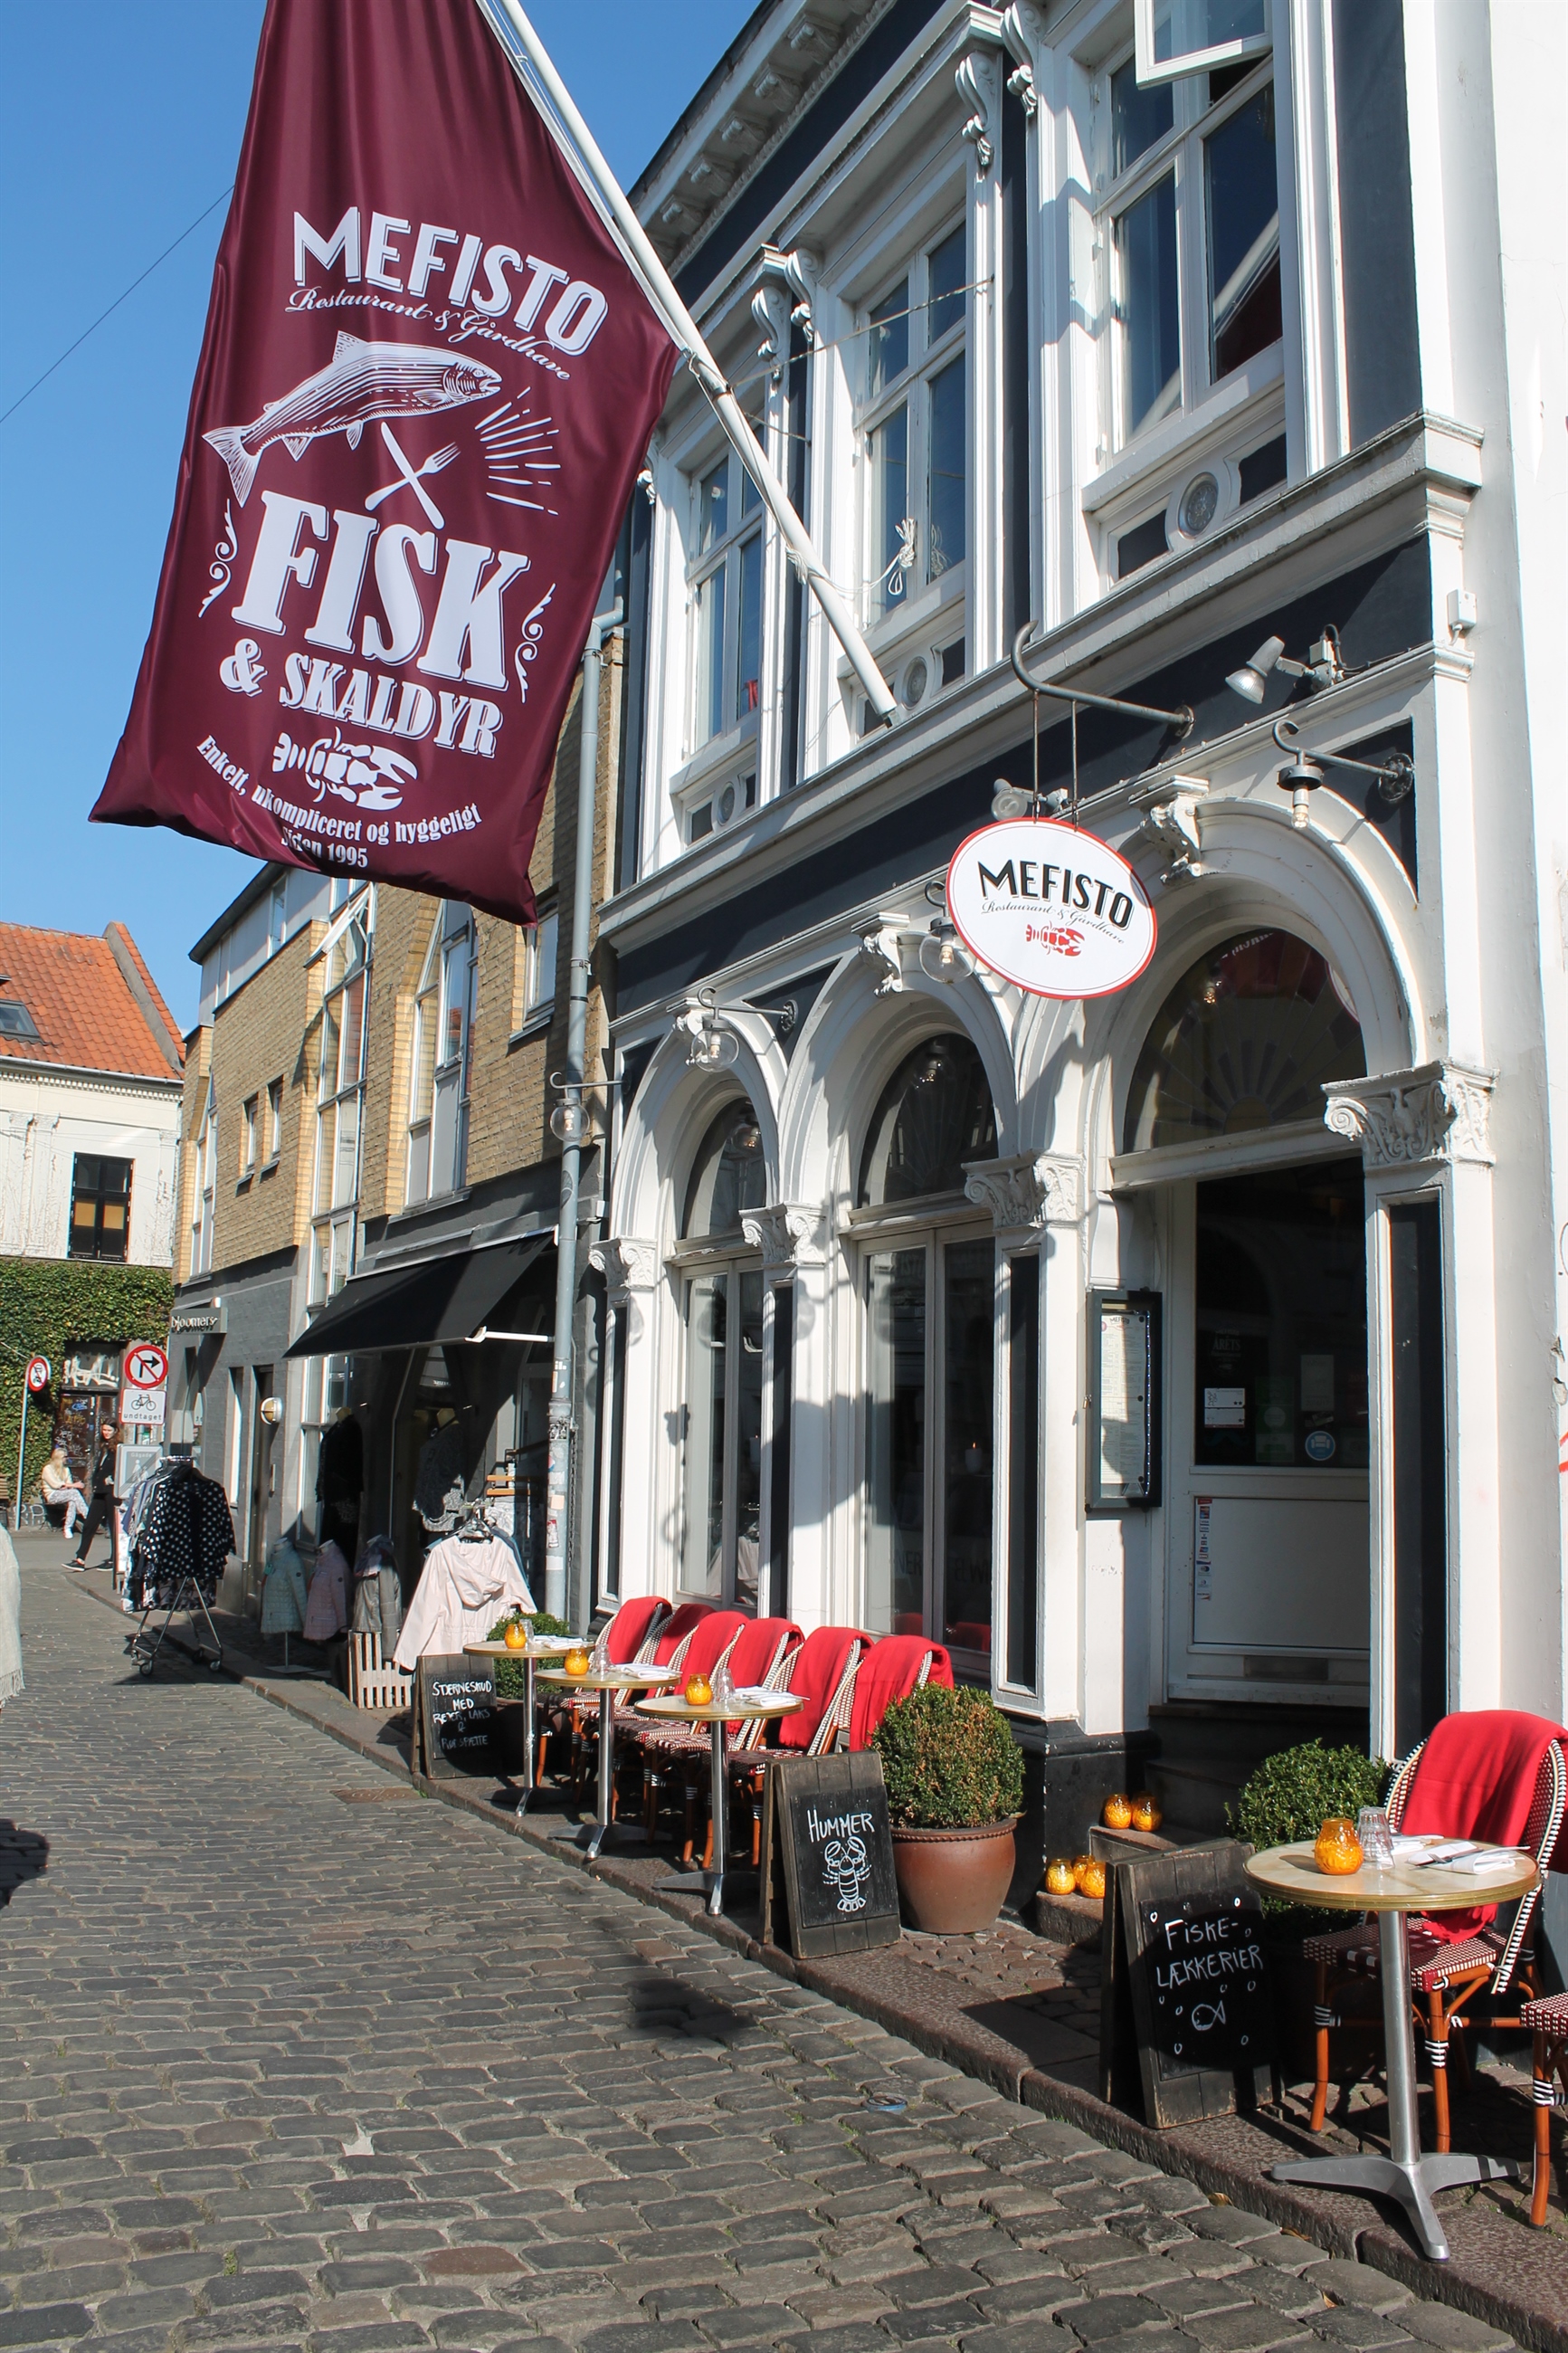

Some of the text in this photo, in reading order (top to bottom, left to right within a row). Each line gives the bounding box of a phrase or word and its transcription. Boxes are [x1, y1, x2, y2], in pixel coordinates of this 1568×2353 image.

[294, 206, 609, 356] MEFISTO
[285, 287, 571, 380] Restaurant & Gårdhave
[231, 491, 531, 691] FISK
[220, 638, 503, 758] & SKALDYR
[196, 735, 482, 845] Enkelt, ukompliceret og hyggeligt
[327, 843, 368, 868] 1995
[977, 859, 1136, 930] MEFISTO
[981, 900, 1056, 915] Restaurant
[123, 1413, 162, 1421] undtaget
[452, 1698, 474, 1711] MED
[468, 1708, 490, 1720] LAKS
[807, 1808, 875, 1843] HUMMER
